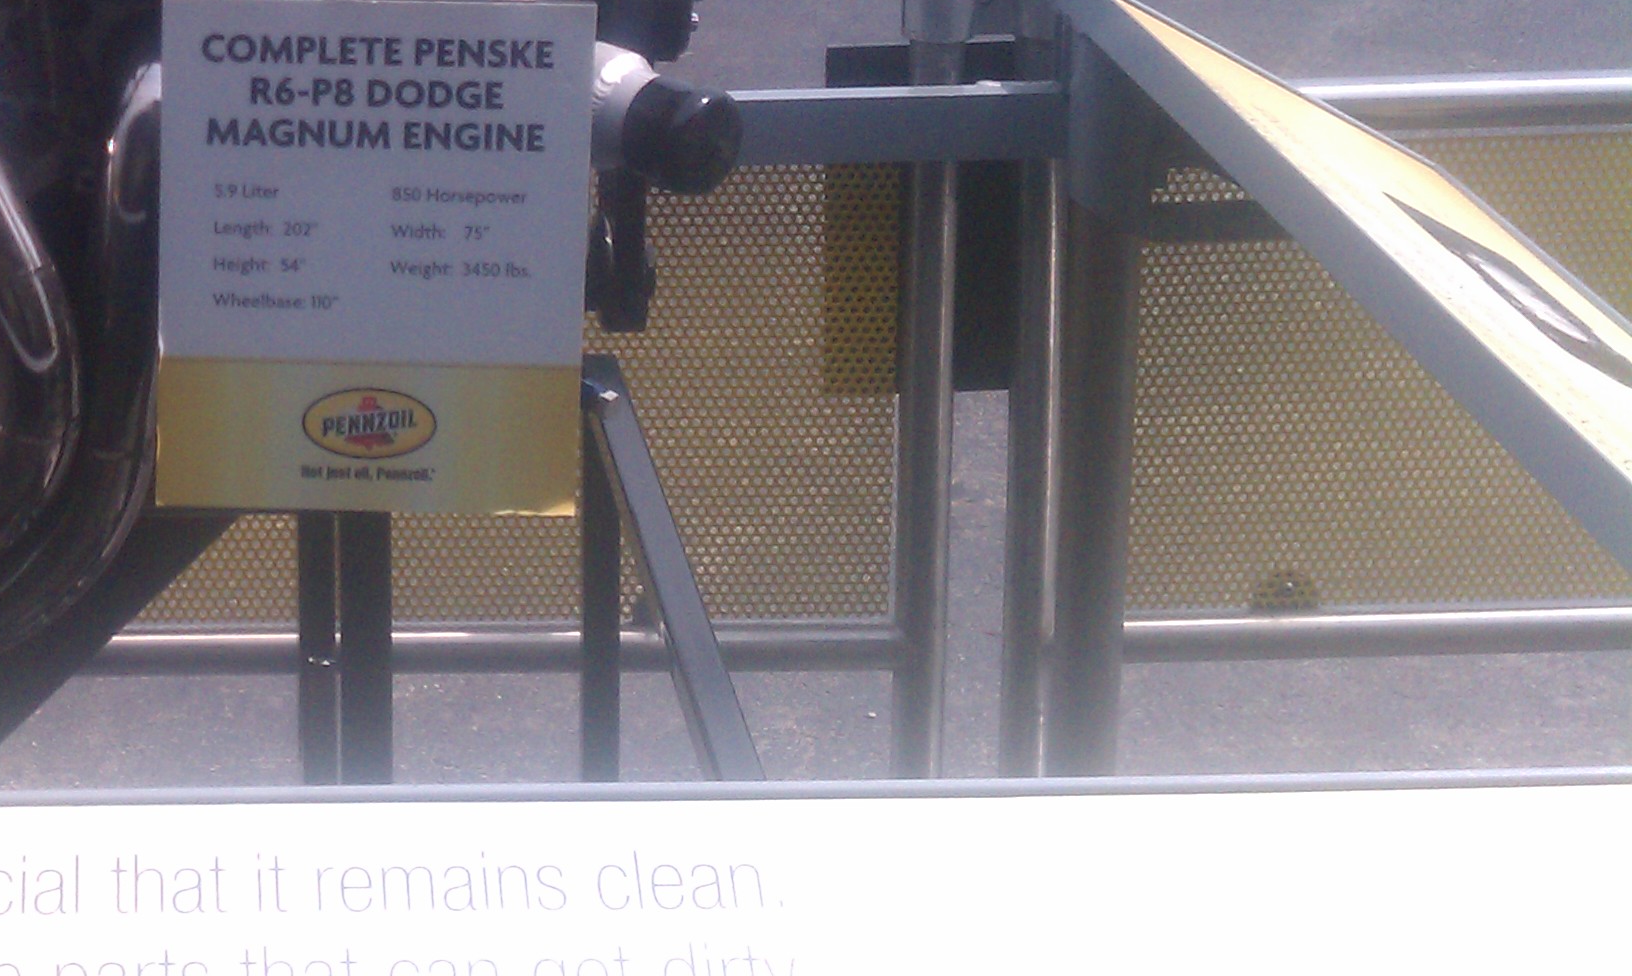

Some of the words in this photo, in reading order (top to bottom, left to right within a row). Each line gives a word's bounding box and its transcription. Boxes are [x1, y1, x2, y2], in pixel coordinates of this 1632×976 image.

[201, 33, 404, 68] COMPLETE
[414, 38, 556, 71] PENSKE
[250, 77, 356, 109] R6-P8
[367, 79, 505, 112] DODGE
[206, 118, 392, 151] MAGNUM
[403, 122, 546, 154] ENGINE
[242, 184, 280, 199] Liter
[391, 186, 422, 203] 850
[426, 188, 527, 207] Horsepower
[321, 410, 417, 437] PENNZOIL
[111, 854, 226, 914] that
[257, 853, 288, 912] it
[317, 851, 569, 912] remains
[597, 850, 786, 911] clean.
